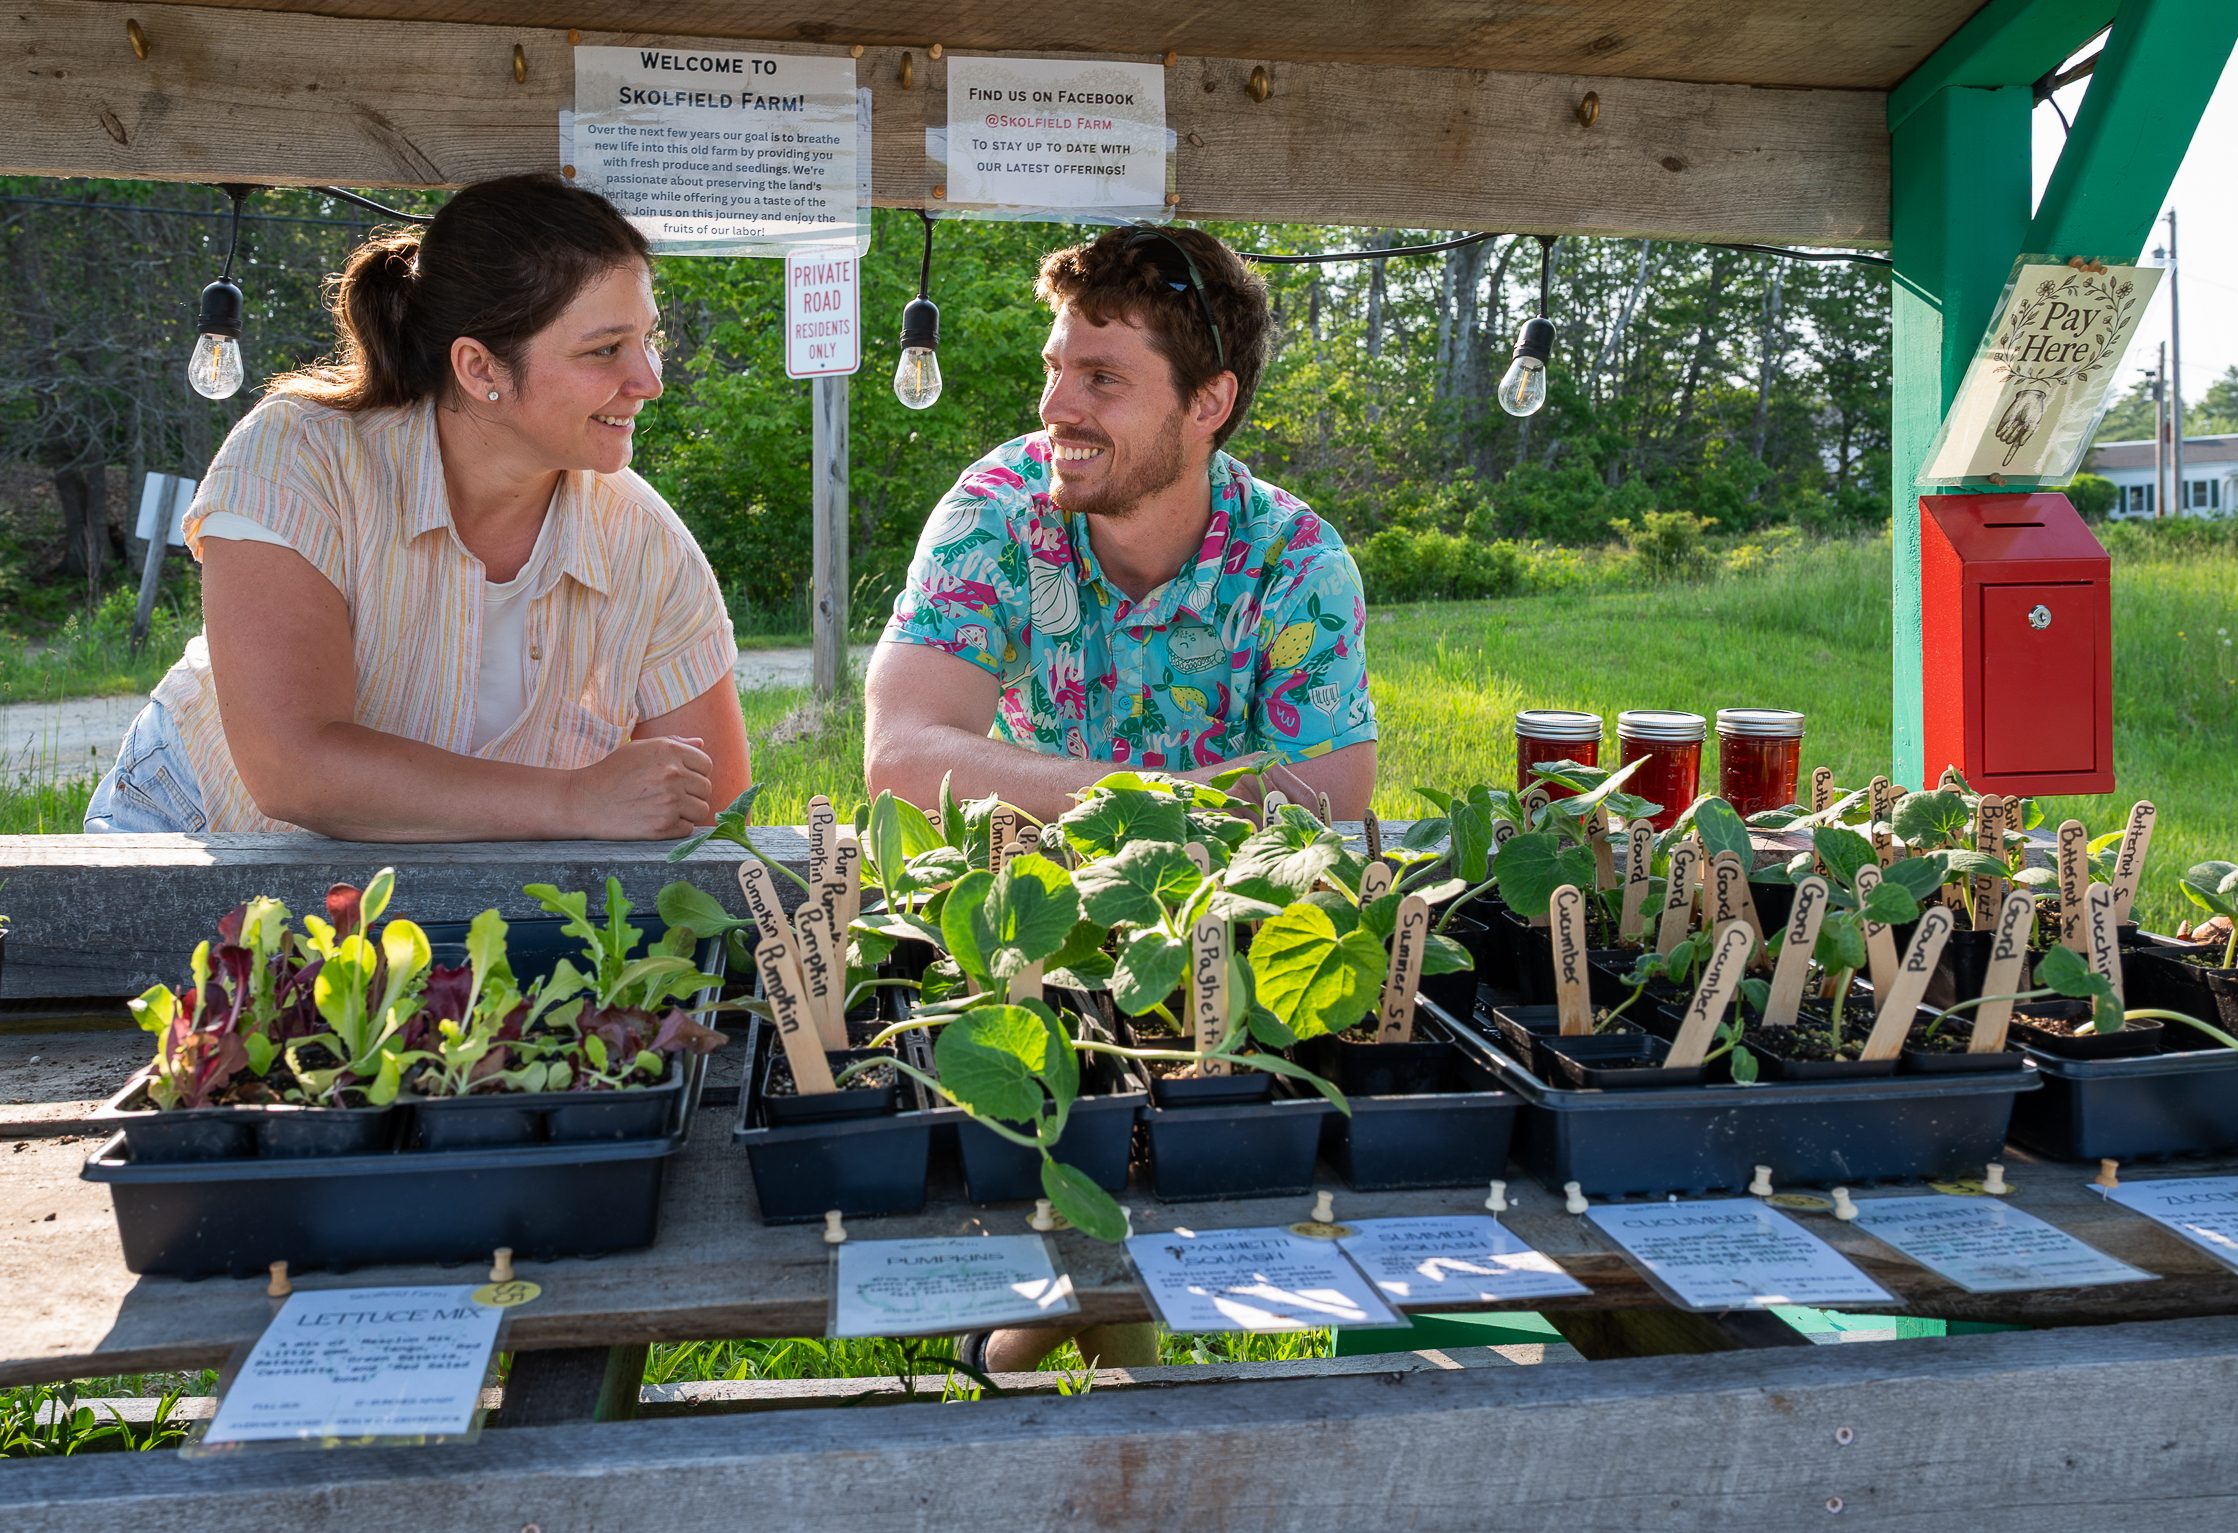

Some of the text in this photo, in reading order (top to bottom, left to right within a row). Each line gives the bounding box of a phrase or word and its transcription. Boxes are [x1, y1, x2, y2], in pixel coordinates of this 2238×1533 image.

[640, 51, 777, 75] WELCOME TO
[619, 86, 804, 112] SKOLFIELD FARM!
[969, 87, 1134, 105] FIND US ON FACEBOOK
[587, 124, 840, 145] Over the next few years our goal is to breathe
[985, 114, 1112, 130] @SKOLFIELD FARM
[594, 140, 833, 163] new life into this old farm by providing you
[972, 139, 1131, 154] TO STAY UP TO DATE WITH
[603, 158, 825, 176] with fresh produce and seedlings. We're
[977, 162, 1126, 175] OUR LATEST OFFERINGS!
[606, 174, 822, 191] passionate about preserving the land's
[602, 189, 826, 207] heritage while offering you a taste of the
[632, 206, 657, 217] Join
[659, 208, 673, 217] us
[675, 209, 689, 218] on
[692, 208, 713, 219] this
[714, 209, 758, 222] journey
[761, 211, 782, 221] and
[784, 212, 815, 225] enjoy
[817, 213, 836, 223] the
[663, 222, 766, 237] fruits of our labor!
[794, 261, 850, 288] PRIVATE
[804, 290, 841, 313] ROAD
[795, 319, 850, 339] RESIDENTS
[2040, 301, 2101, 338] Pay
[809, 342, 836, 360] ONLY
[2018, 334, 2089, 363] Here
[811, 813, 833, 884] Pumpkin
[2119, 805, 2155, 879] Butternut
[1629, 827, 1651, 885] Gourd
[1977, 805, 2004, 921] Buttnut
[2061, 826, 2084, 908] Butternut
[1668, 848, 1696, 910] Gourd
[742, 868, 778, 939] Pumpkin
[1717, 866, 1738, 923] Gourd
[1790, 882, 1825, 946] Gourd
[1557, 890, 1580, 985] Cucumber
[1994, 895, 2031, 961] Gourd
[798, 908, 828, 998] Pumpkin
[1394, 912, 1423, 997] Summer
[1906, 913, 1949, 973] Gourd
[1694, 928, 1748, 1021] Cucumber
[758, 945, 799, 1034] Pumpkin
[1622, 1214, 1759, 1228] CUCUMBER
[1378, 1230, 1476, 1242] SUMMER
[1388, 1241, 1488, 1251] SQUASH
[886, 1253, 1005, 1266] PUMPKINS
[297, 1306, 484, 1327] LETTUCE MIX
